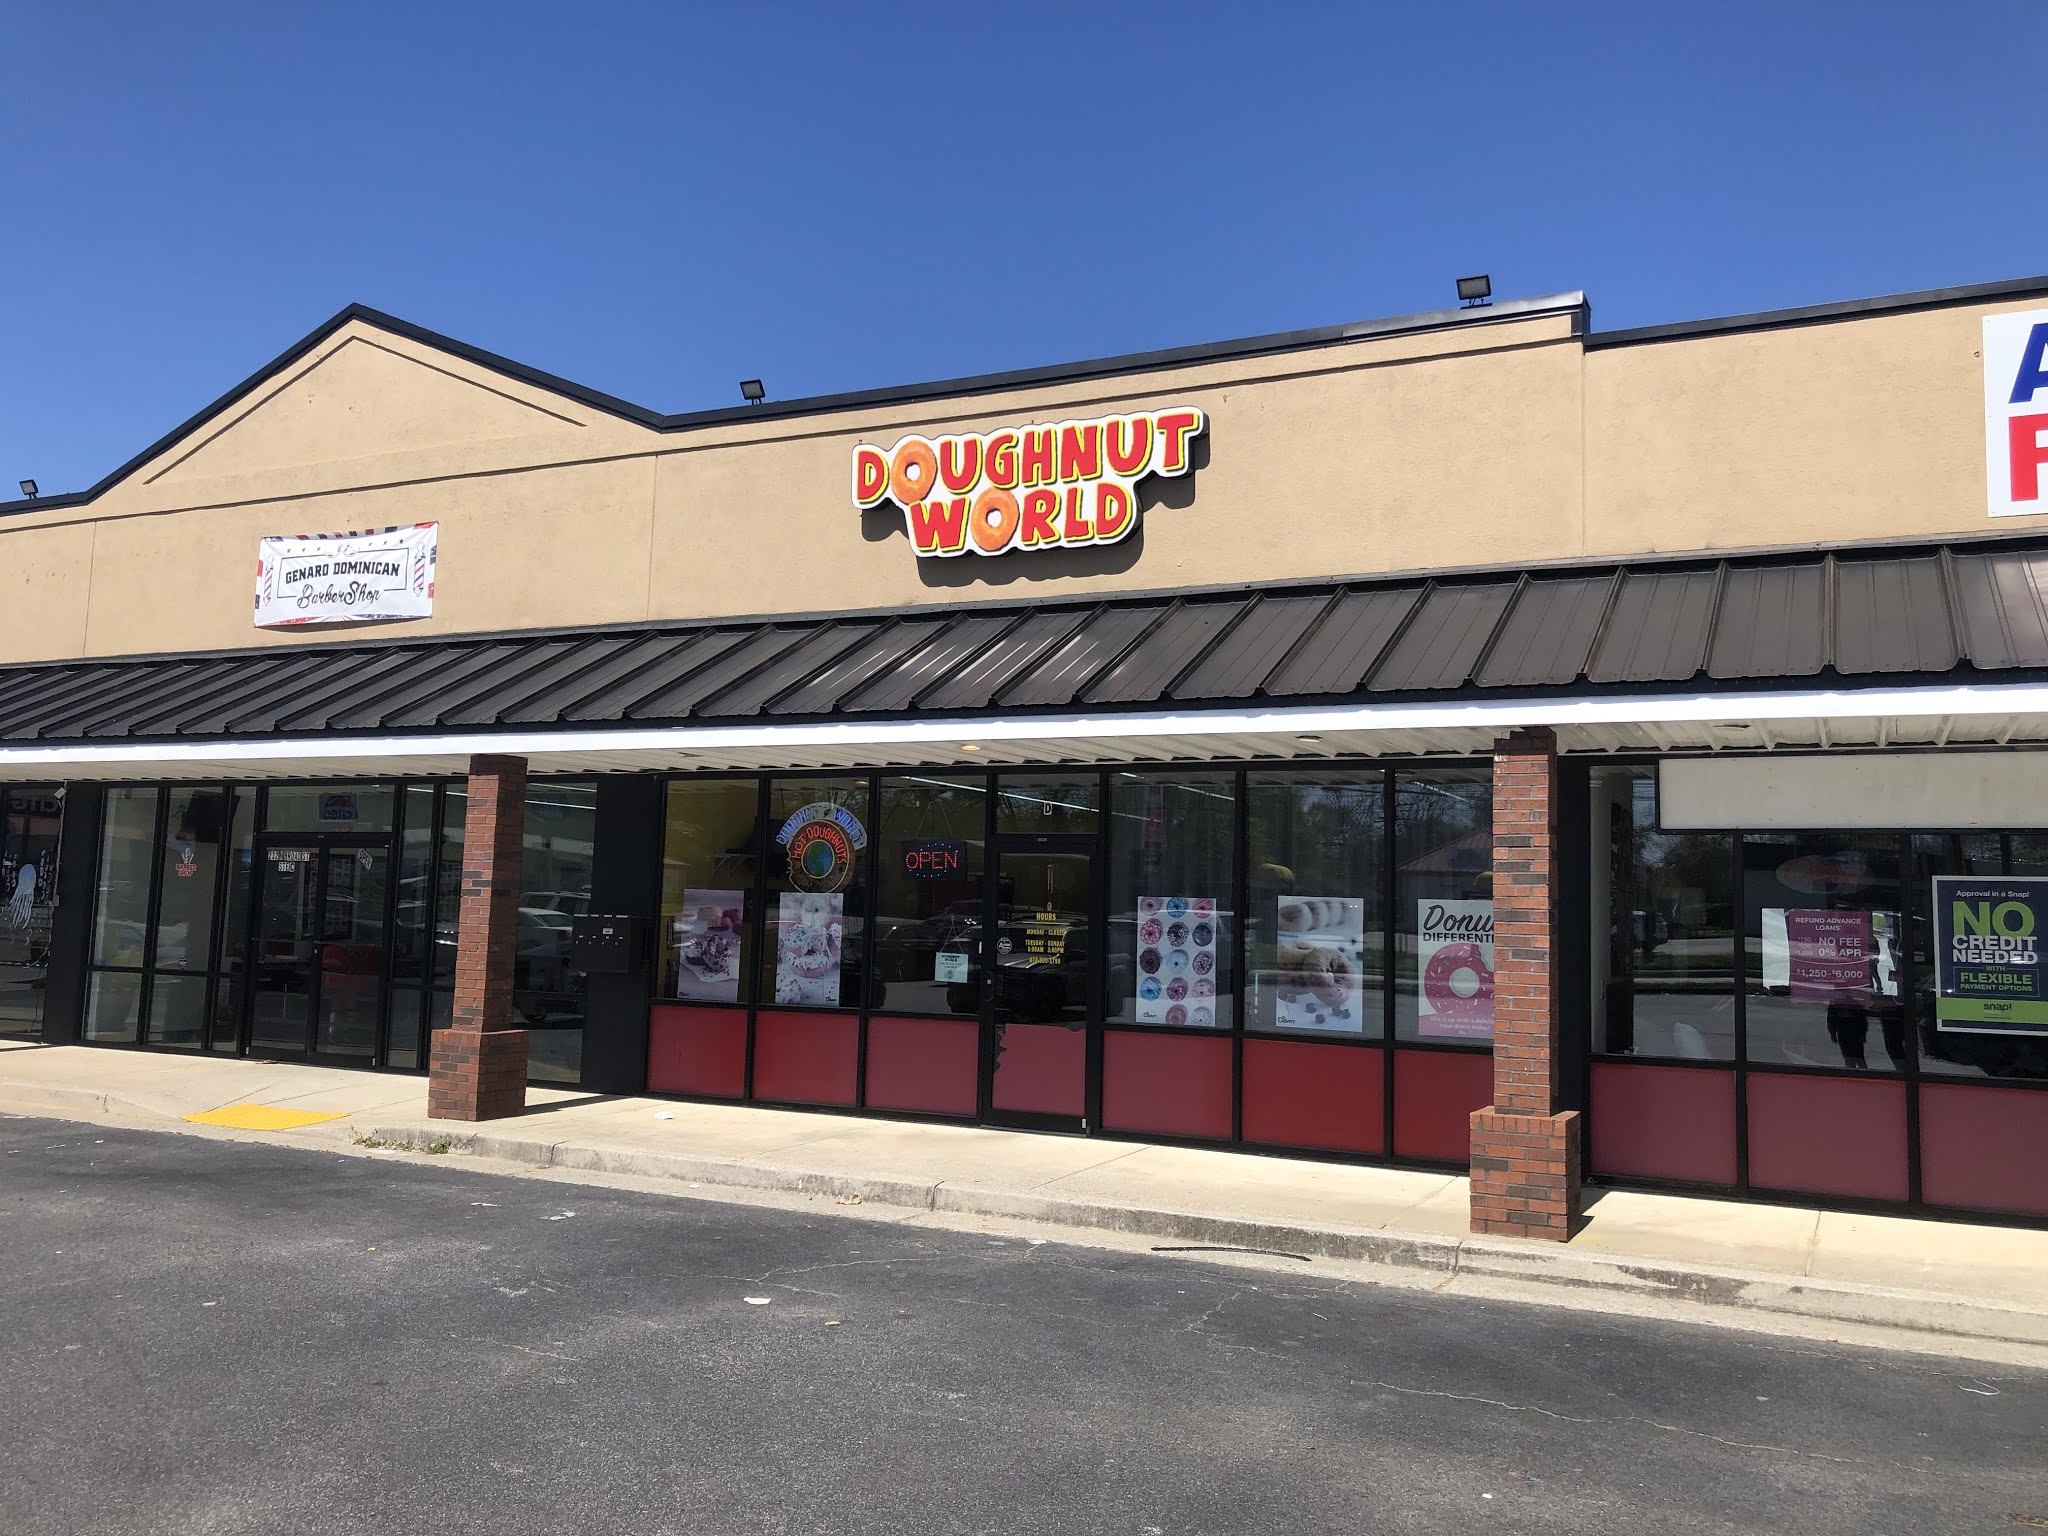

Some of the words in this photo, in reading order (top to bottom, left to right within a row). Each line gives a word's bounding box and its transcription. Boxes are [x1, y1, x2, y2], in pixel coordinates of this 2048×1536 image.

[857, 413, 1198, 503] DOUGHNUT
[908, 482, 1131, 552] WORLD
[286, 563, 329, 584] GENARO
[333, 561, 401, 577] DOMINICAN
[791, 833, 807, 860] HOT
[806, 825, 847, 864] DOUGHNUTS
[905, 851, 958, 869] OPEN
[1953, 901, 2035, 938] NO
[1819, 937, 1836, 946] NO
[1839, 938, 1861, 946] FEE
[1953, 935, 2038, 951] CREDIT
[1819, 948, 1836, 957] 0%
[1839, 949, 1862, 957] APR
[1953, 950, 2038, 965] NEEDED
[1960, 972, 2032, 985] FLEXIBLE
[1983, 1003, 2012, 1012] snap!
[1278, 1015, 1295, 1024] Dawn
